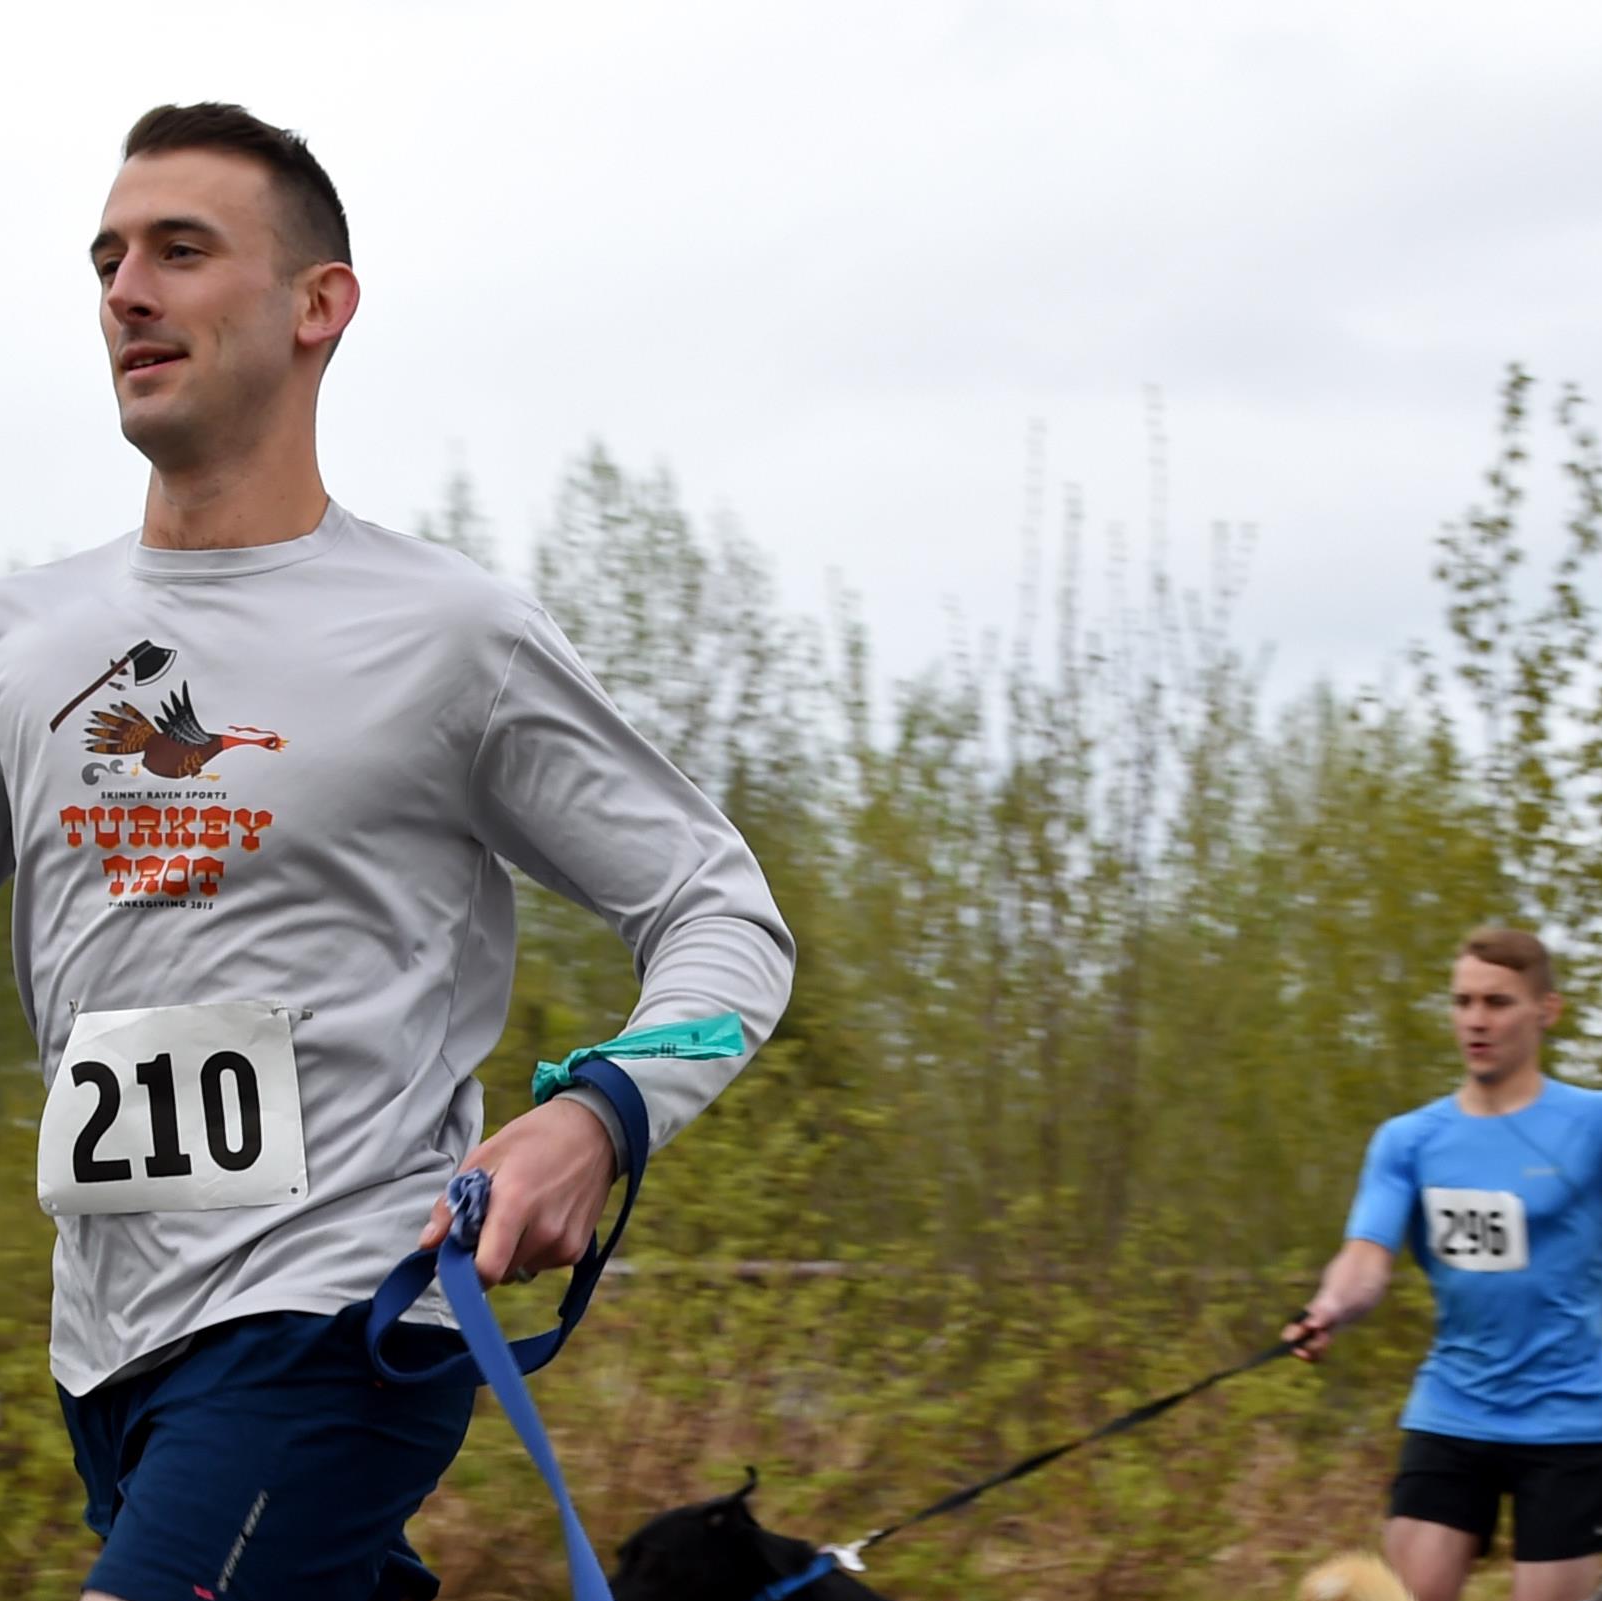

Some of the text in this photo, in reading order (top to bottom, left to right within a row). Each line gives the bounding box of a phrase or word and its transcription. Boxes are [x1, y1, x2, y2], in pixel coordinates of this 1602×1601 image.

[101, 791, 227, 800] SKINNY RAVEN SPORTS
[59, 805, 273, 851] TURKEY
[101, 854, 225, 897] TROT
[71, 1050, 263, 1184] 210
[1439, 1209, 1508, 1257] 296
